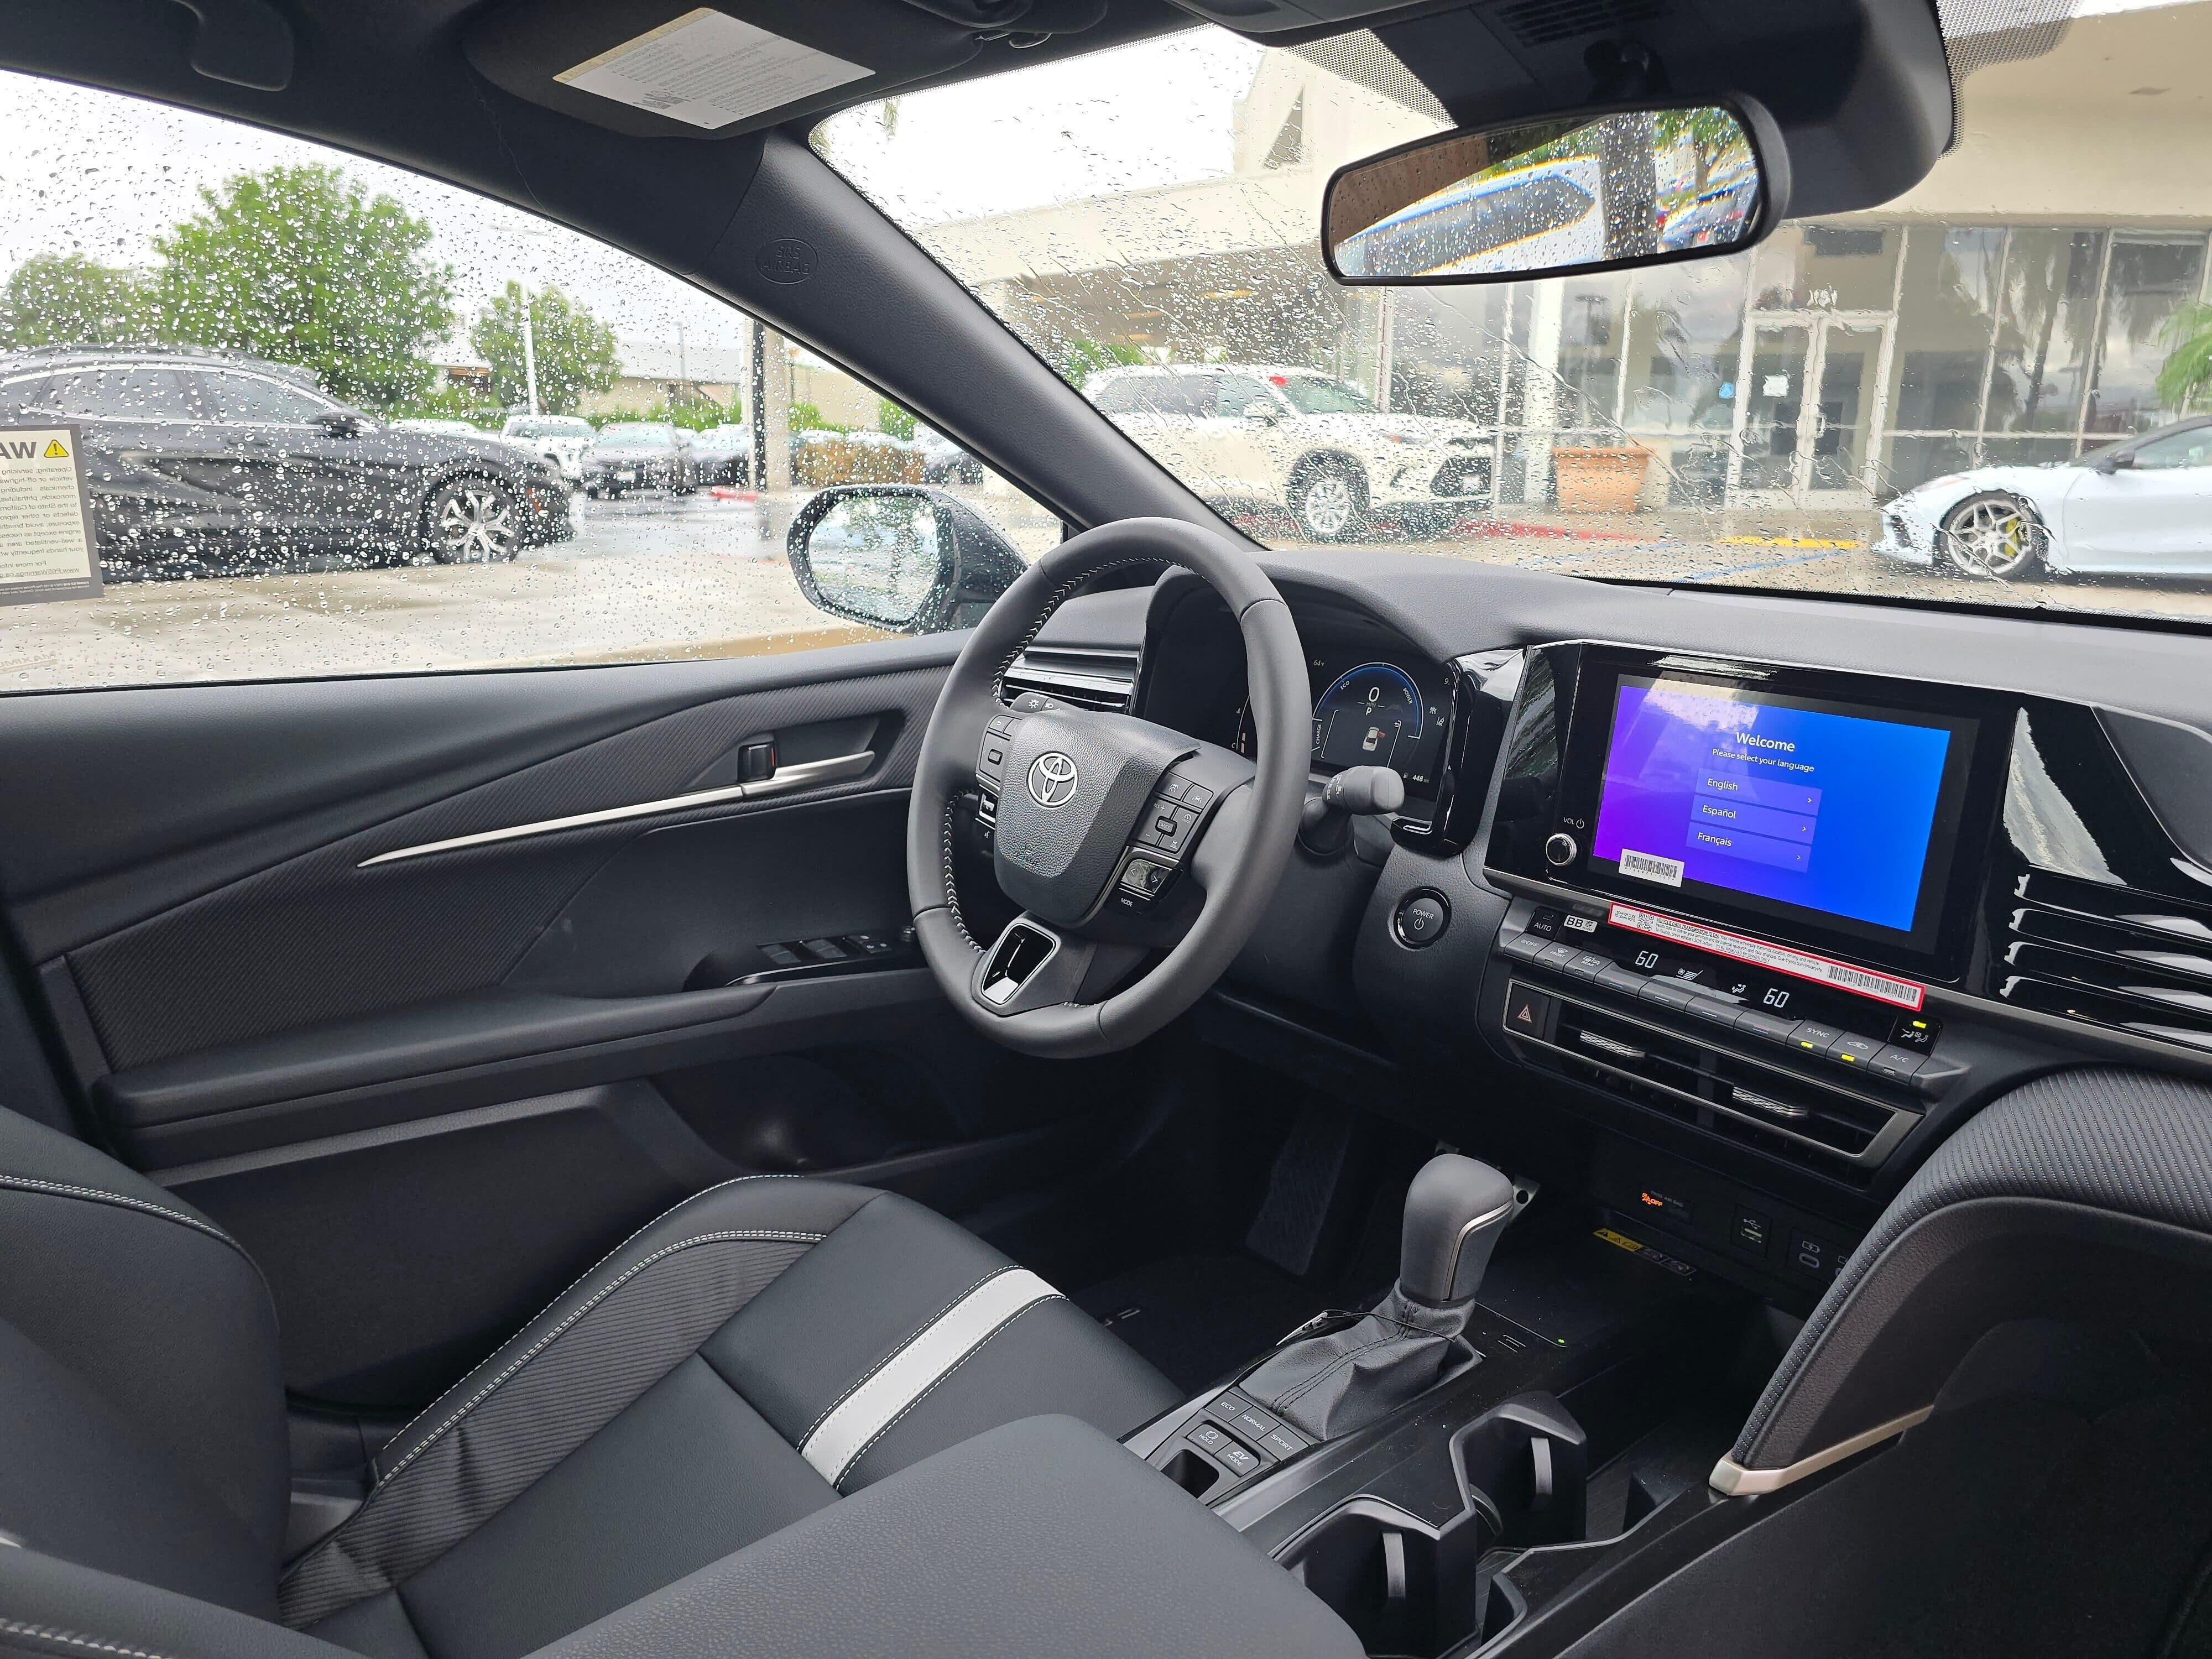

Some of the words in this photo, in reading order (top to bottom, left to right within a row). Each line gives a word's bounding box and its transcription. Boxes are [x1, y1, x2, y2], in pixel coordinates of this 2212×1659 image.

[1369, 687, 1380, 702] 0
[1402, 687, 1413, 705] POWER
[1365, 707, 1372, 716] P
[1736, 732, 1796, 752] Welcome
[1712, 748, 1735, 759] Please
[1736, 753, 1759, 763] select
[1759, 757, 1776, 765] your
[1777, 759, 1814, 773] language
[1707, 778, 1738, 791] English
[1702, 805, 1736, 819] Español
[1563, 817, 1575, 825] VOL
[1698, 832, 1732, 847] Français
[1120, 898, 1133, 907] MODE
[1412, 909, 1434, 920] POWER
[1533, 922, 1552, 932] AUTO
[1567, 916, 1584, 928] BB
[1656, 917, 1672, 926] VEHICLE
[1635, 950, 1659, 969] 60
[1763, 988, 1790, 1008] 60
[1806, 1027, 1830, 1039] SYNC
[1890, 1054, 1910, 1063] A/C
[1220, 1401, 1235, 1411] ECO
[1241, 1414, 1267, 1432] NORMAL
[1198, 1434, 1213, 1444] HOLD
[1270, 1433, 1293, 1451] SPORT
[1227, 1453, 1244, 1467] MODE
[1233, 1451, 1250, 1460] EV
